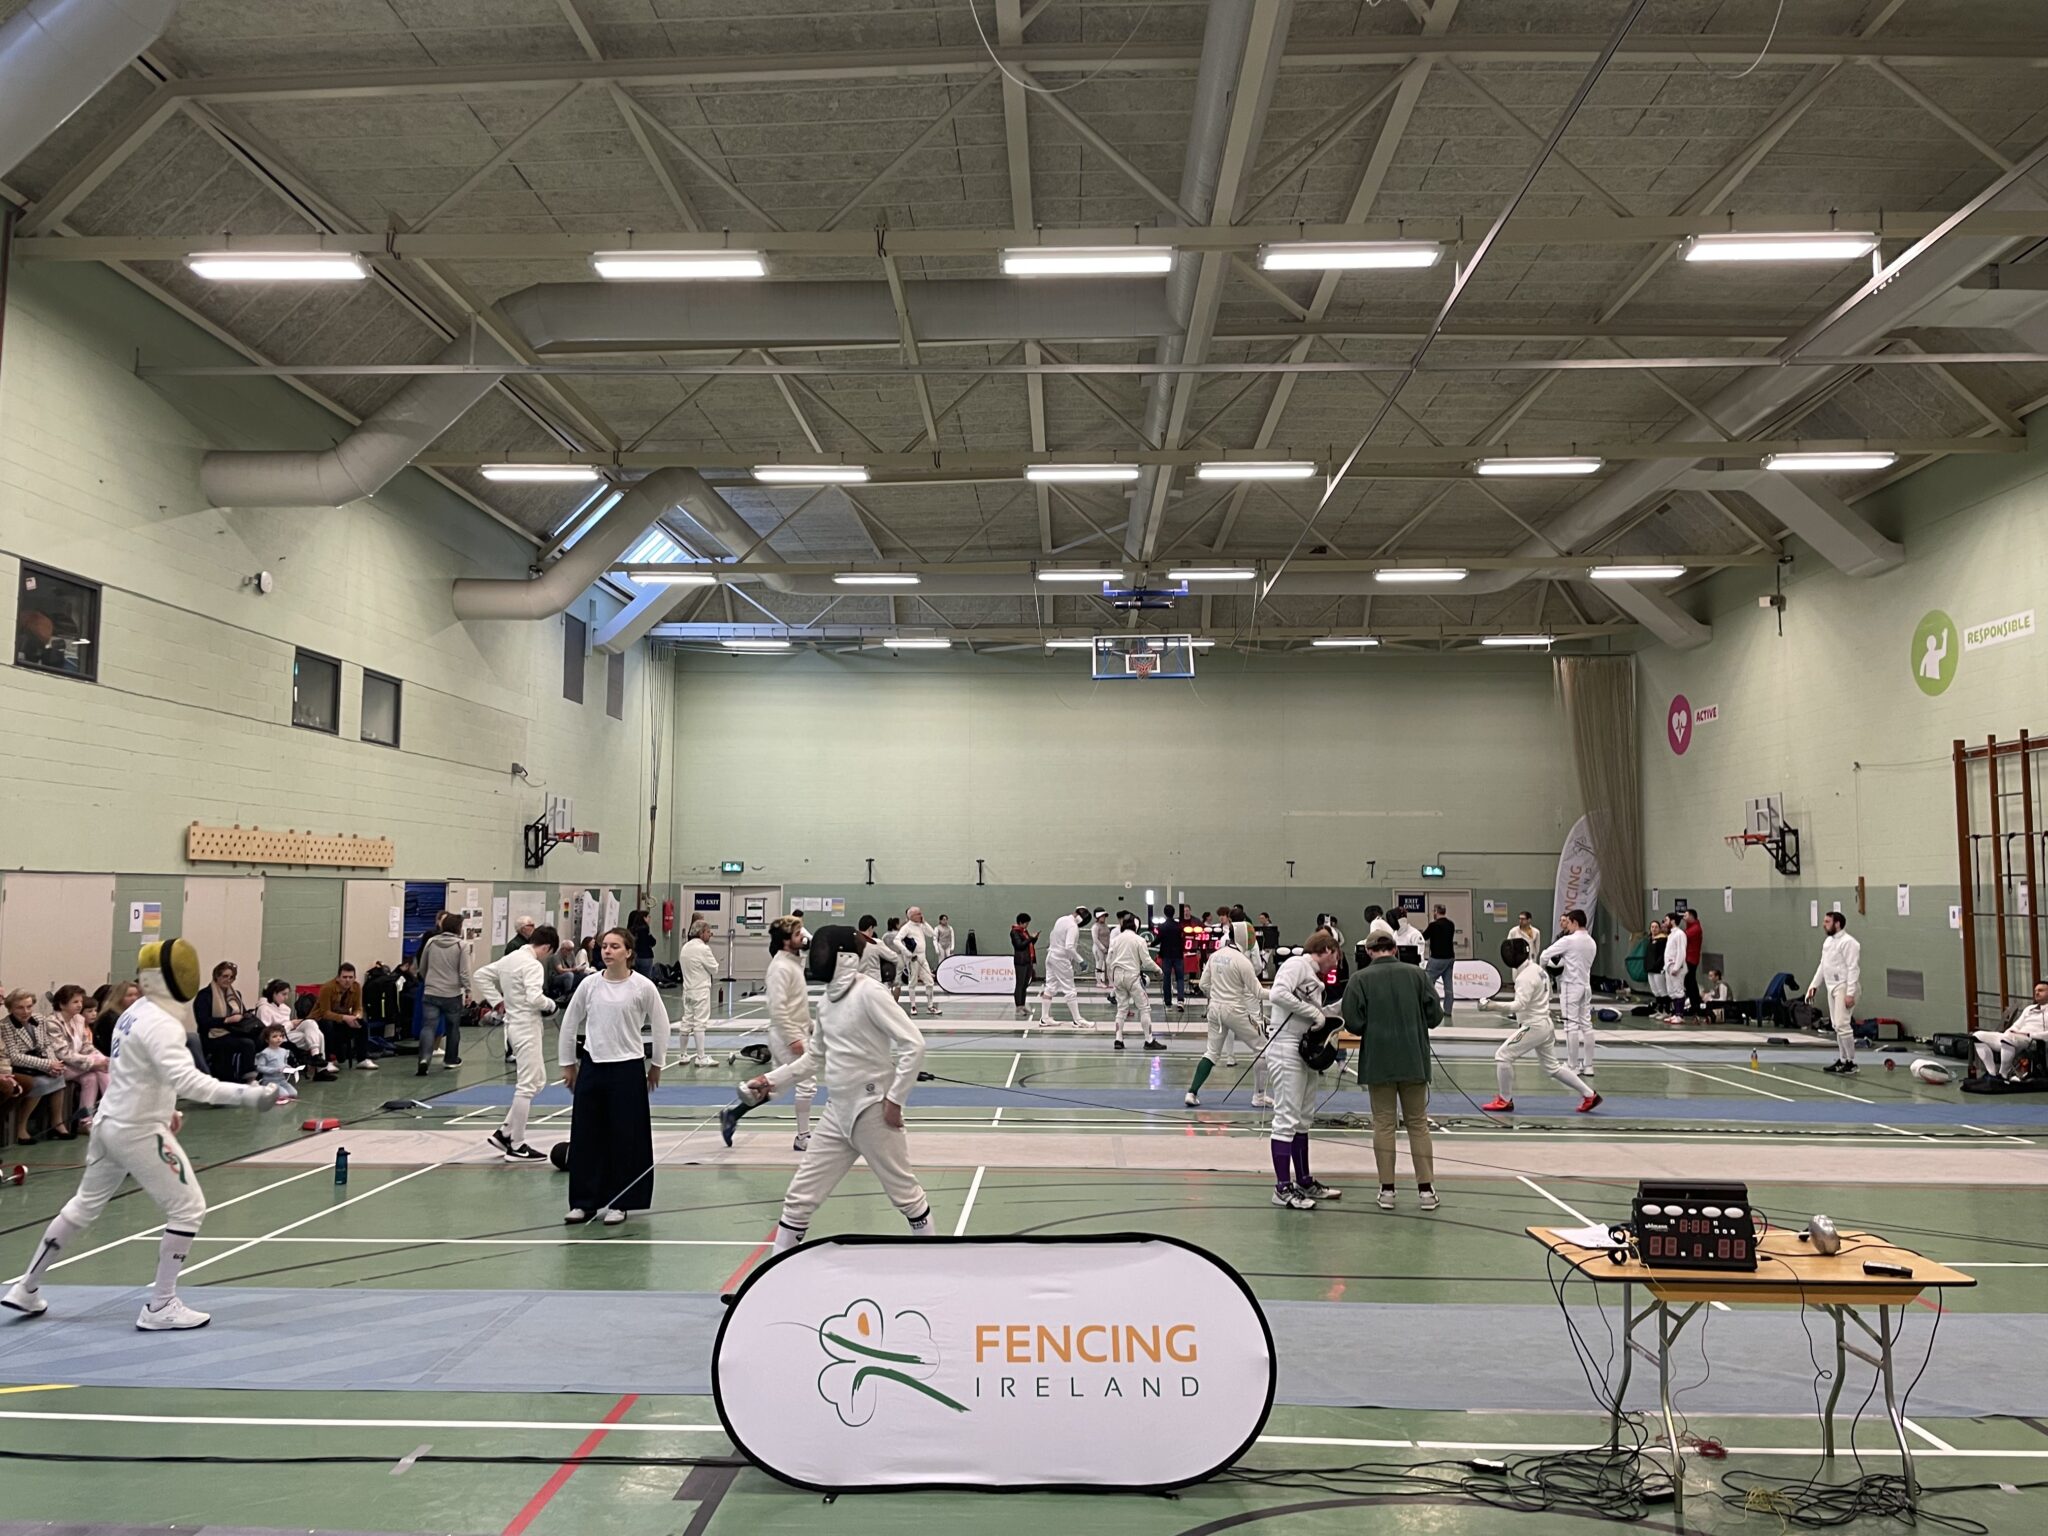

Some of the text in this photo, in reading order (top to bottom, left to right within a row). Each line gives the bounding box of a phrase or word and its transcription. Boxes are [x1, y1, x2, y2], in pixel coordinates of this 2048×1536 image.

[1967, 615, 2031, 644] RESPONSIBLE
[1695, 706, 1716, 721] ACTIVE
[1565, 864, 1582, 911] NCING
[133, 908, 140, 919] D
[980, 968, 1014, 976] FENCIN
[1454, 973, 1489, 981] ENCING
[975, 1323, 1198, 1363] FENCING
[975, 1375, 1199, 1398] IRELAND
